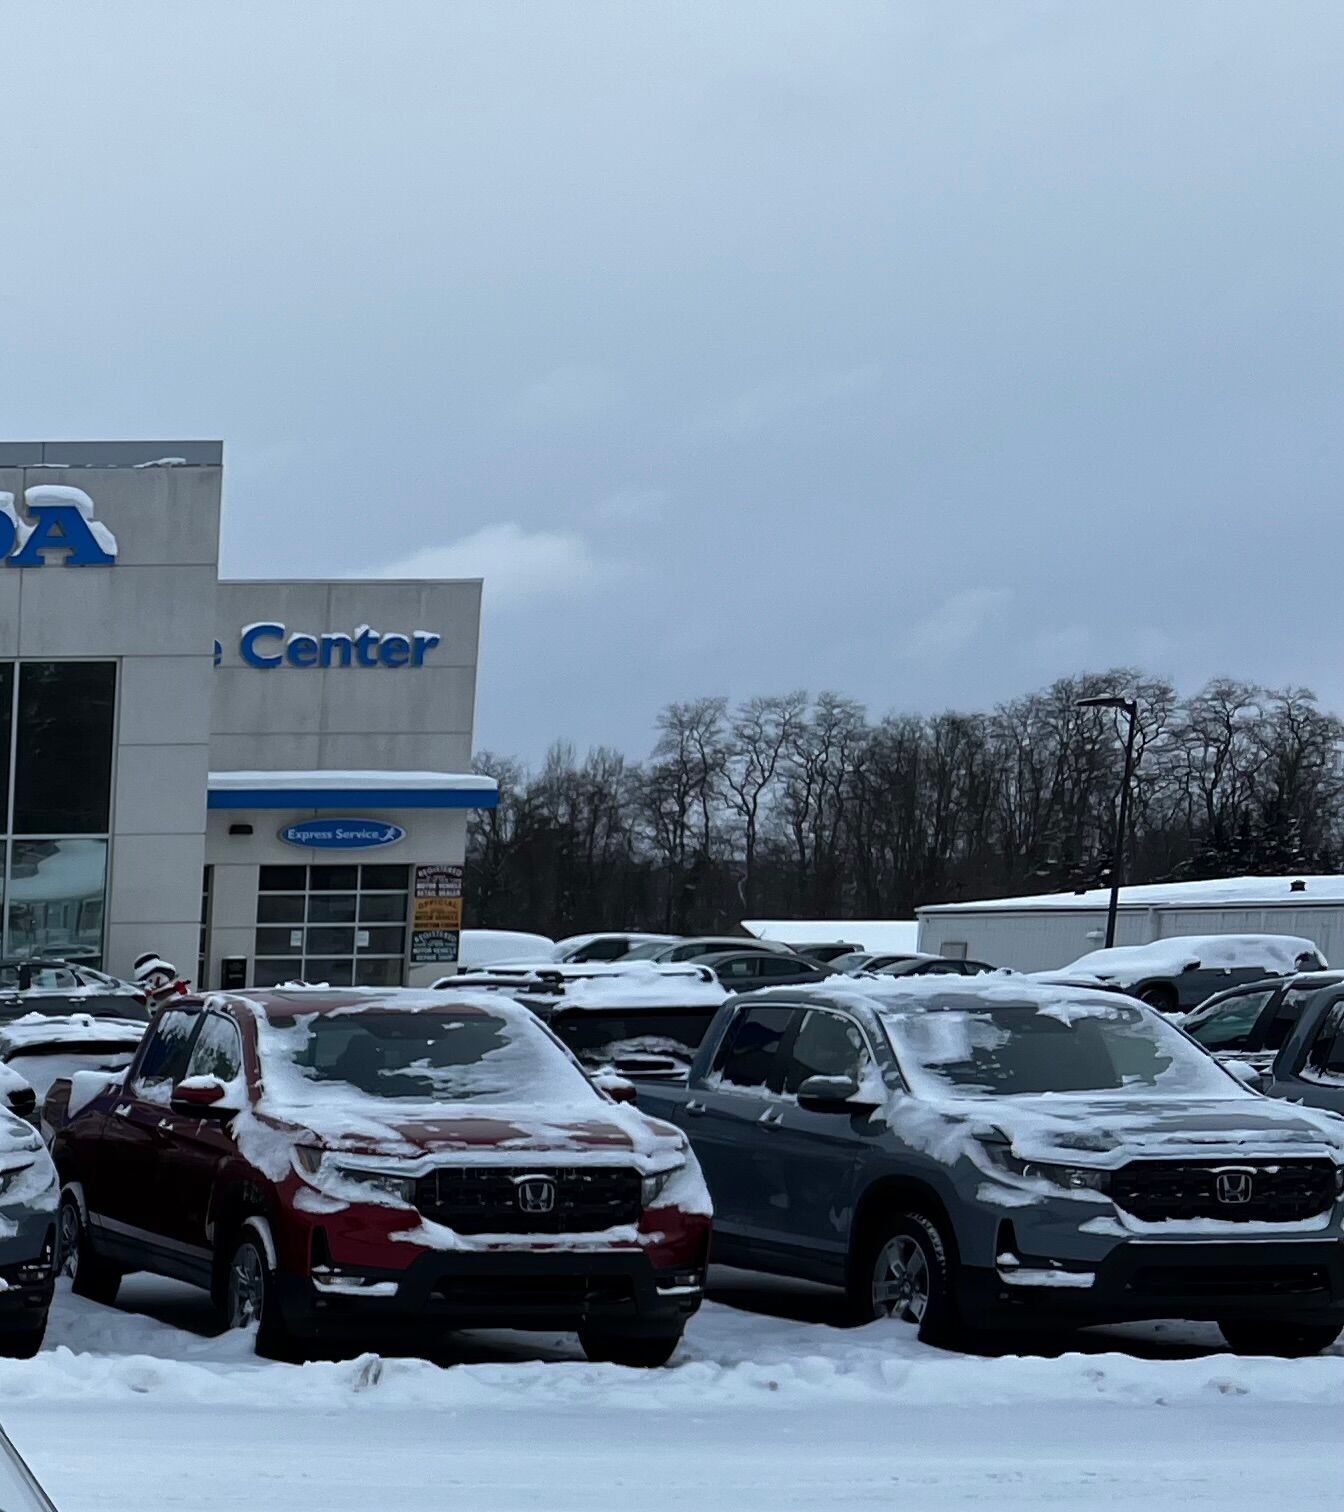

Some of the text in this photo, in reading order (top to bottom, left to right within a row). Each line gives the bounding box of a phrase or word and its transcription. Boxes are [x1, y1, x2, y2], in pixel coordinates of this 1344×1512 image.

[240, 623, 441, 669] Center
[287, 828, 380, 843] Express Service
